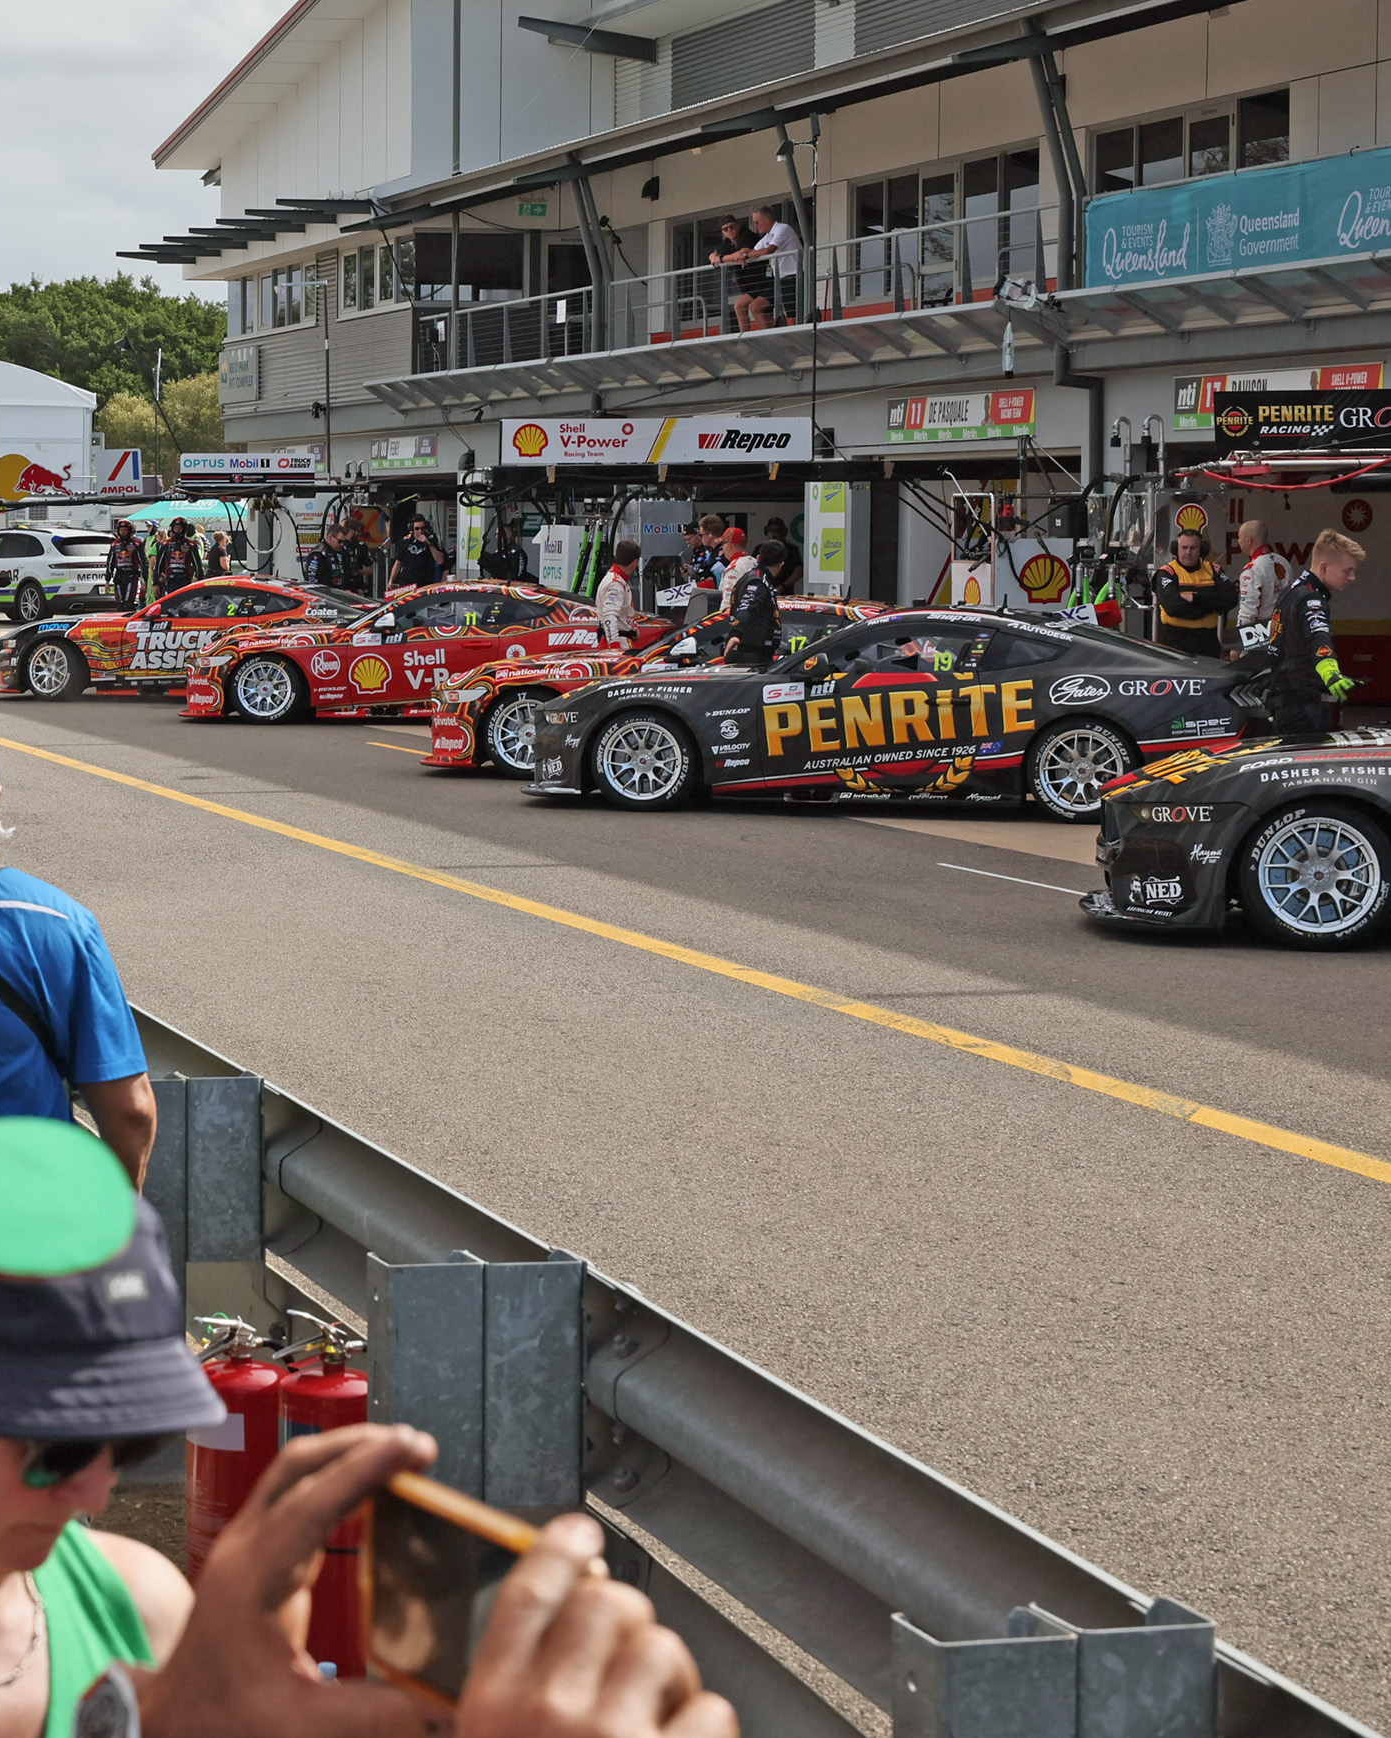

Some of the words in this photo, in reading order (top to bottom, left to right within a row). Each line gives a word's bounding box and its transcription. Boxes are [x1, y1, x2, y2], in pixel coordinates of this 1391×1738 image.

[1369, 187, 1391, 200] TOUR
[1239, 207, 1300, 233] Queensland
[1121, 223, 1154, 237] TOURISM
[1121, 239, 1128, 248] &
[1128, 235, 1154, 248] EVENTS
[1239, 233, 1300, 256] Government
[1102, 219, 1190, 279] Queensland
[1177, 382, 1197, 406] nti
[889, 403, 904, 423] nti
[910, 403, 923, 425] 11
[928, 402, 937, 423] DE
[937, 400, 970, 425] PASQUALE
[1258, 404, 1335, 423] PENRITE
[1339, 407, 1391, 428] GRO
[1179, 415, 1197, 427] Merlin
[1216, 416, 1254, 426] PENRITE
[559, 423, 585, 434] Shell
[1260, 425, 1311, 435] RACING
[560, 435, 628, 449] V-Power
[720, 429, 792, 453] Repco
[564, 451, 586, 459] Racing
[183, 459, 225, 468] OPTUS
[229, 458, 259, 469] Mobil
[261, 458, 271, 469] 1
[100, 485, 140, 494] AMPOL
[644, 523, 675, 534] Mobil
[543, 566, 563, 580] OPTUS
[227, 604, 236, 616] 2
[305, 607, 339, 616] Coates
[464, 612, 478, 626] 11
[866, 617, 890, 626] PAYNE
[927, 612, 981, 623] Snap-on
[38, 622, 70, 631] move
[152, 621, 168, 631] nti
[1019, 624, 1074, 642] AUTODESK
[135, 630, 219, 650] TRUCK
[249, 638, 281, 647] national
[385, 633, 403, 643] nti
[571, 630, 598, 648] Rep
[788, 636, 808, 654] 17
[130, 650, 188, 670] ASSI
[314, 651, 340, 675] Rheem
[403, 649, 445, 667] Shell
[932, 652, 953, 672] 19
[234, 657, 261, 681] DUNLOP
[509, 668, 548, 678] national
[549, 667, 572, 676] tiles
[607, 687, 644, 698] DASHER
[657, 686, 693, 694] FISHER
[810, 680, 836, 696] nti
[1056, 678, 1106, 698] Gates
[1119, 679, 1203, 696] GROVE
[517, 692, 528, 701] 17
[619, 693, 661, 701] TASMANIAN
[549, 711, 578, 724] GROVE
[712, 707, 751, 717] DUNLOP
[762, 679, 1036, 757] PENRITE
[488, 703, 505, 746] DUNLOP
[720, 726, 740, 734] ACL
[1171, 716, 1231, 736] alspec
[440, 739, 464, 750] Repco
[601, 723, 619, 752] MAXX
[719, 742, 751, 751] VELOCITY
[1092, 725, 1131, 765] DUNLOP
[596, 752, 607, 774] SPORT
[724, 758, 751, 768] Repco
[803, 755, 871, 771] AUSTRALIAN
[874, 751, 913, 764] OWNED
[916, 747, 948, 759] SINCE
[951, 745, 977, 757] 1926
[1239, 757, 1294, 773] FORD
[547, 761, 563, 775] NED
[1260, 767, 1320, 783] DASHER
[665, 755, 690, 801] DUNLOP
[1282, 777, 1352, 788] TASMANIAN
[1357, 777, 1378, 787] GIN
[1033, 778, 1051, 807] MAXX
[1046, 798, 1077, 819] SPORT
[1152, 805, 1211, 823] GROVE
[1251, 808, 1306, 862] DUNLOP
[1146, 881, 1182, 900] NED
[1126, 905, 1154, 915] AUSTRALIAN
[1154, 910, 1174, 918] WHISKY
